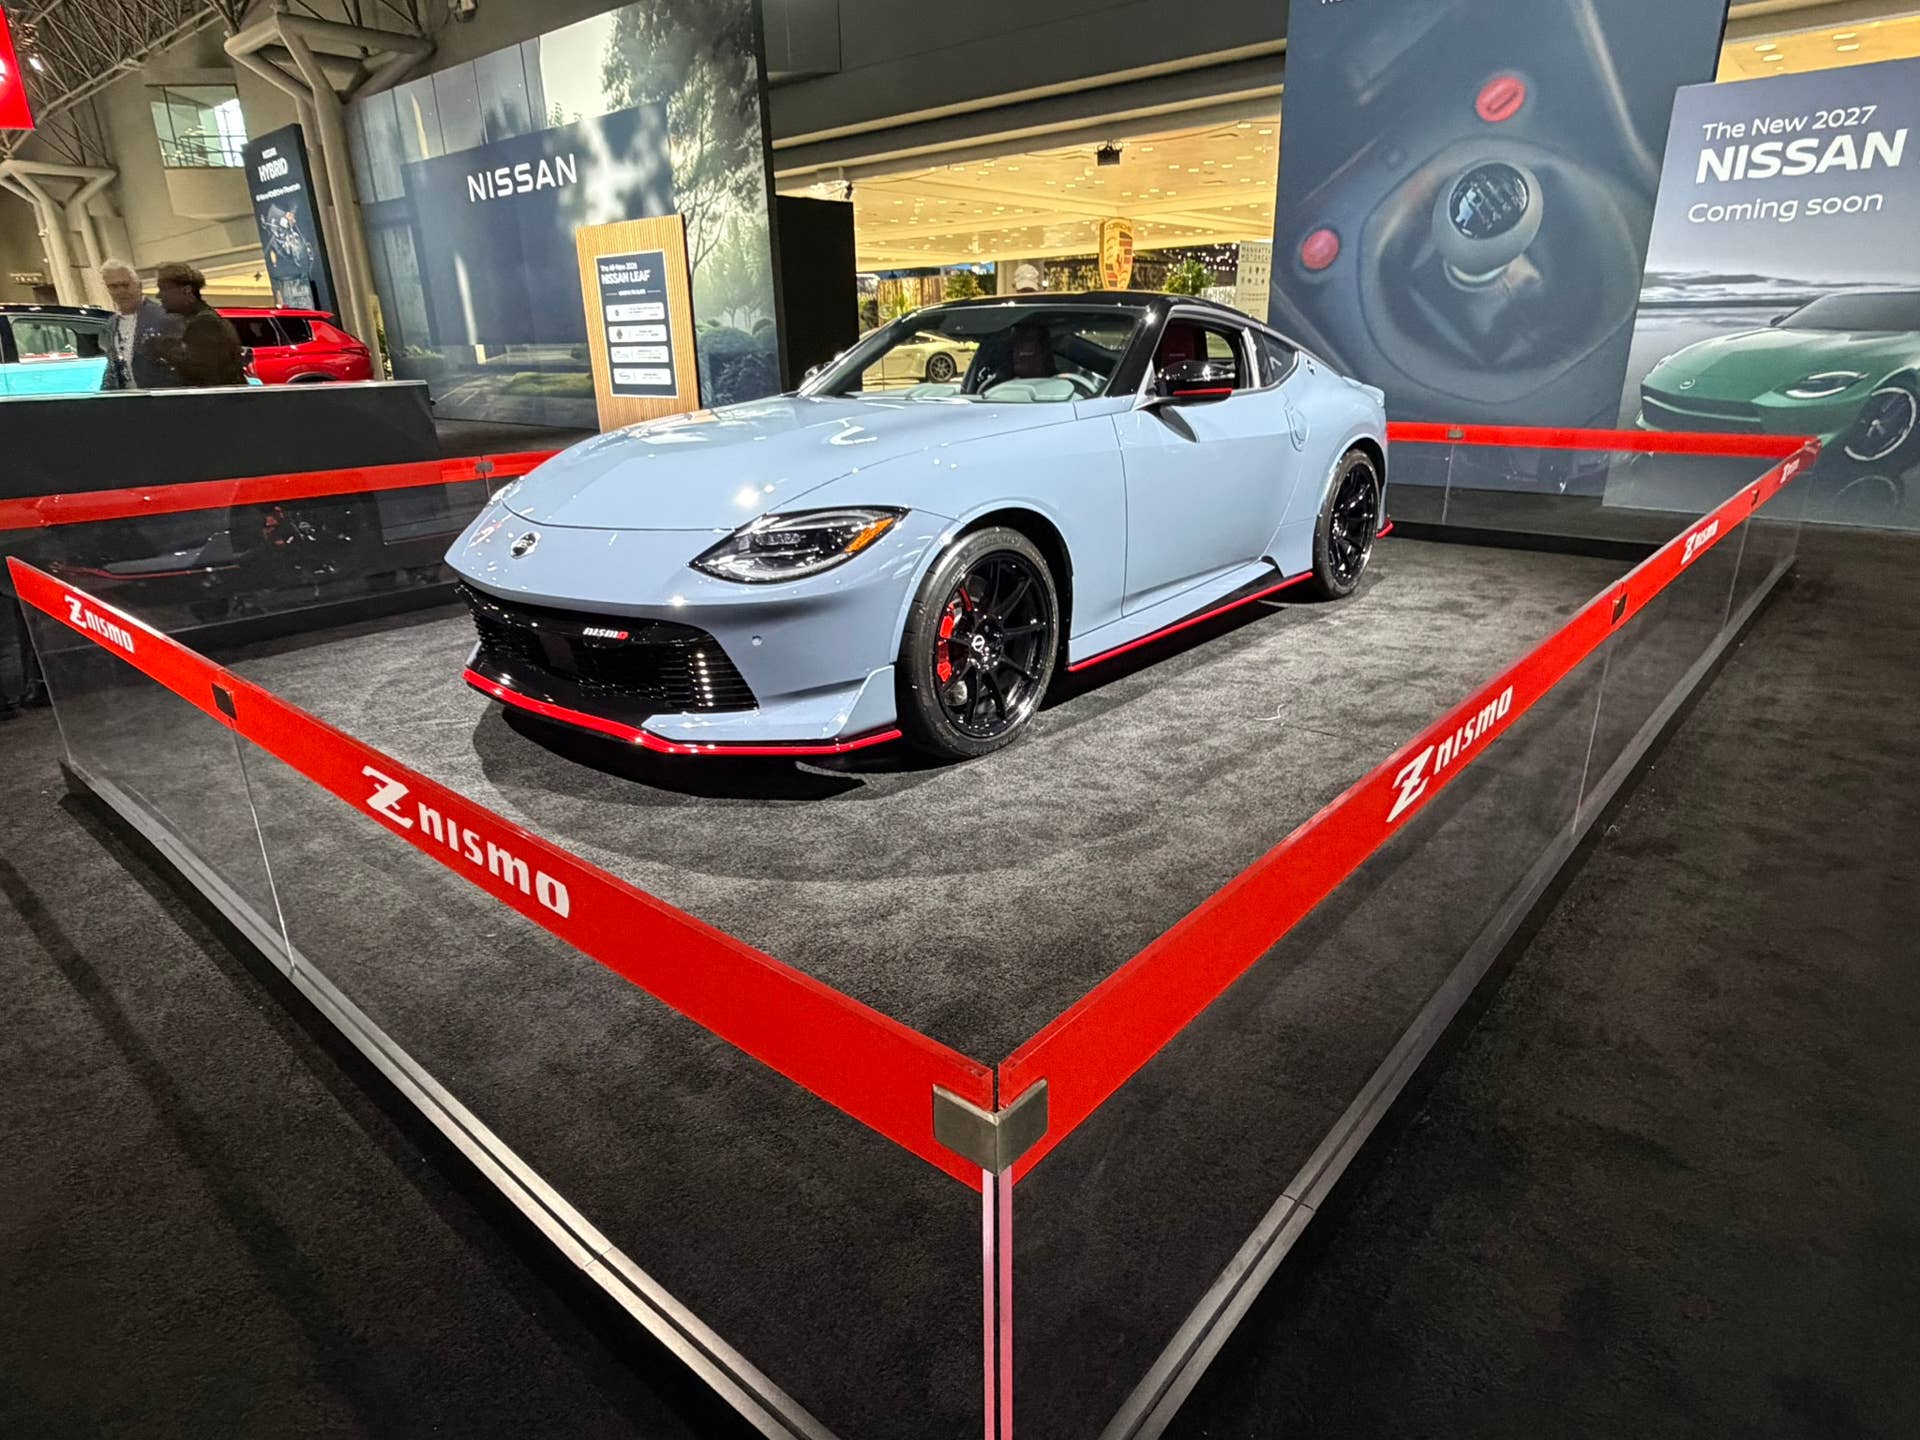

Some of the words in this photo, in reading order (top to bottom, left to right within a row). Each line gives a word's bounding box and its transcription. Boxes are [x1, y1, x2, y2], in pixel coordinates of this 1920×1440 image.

[1702, 122, 1746, 142] The
[1751, 115, 1809, 137] New
[1811, 104, 1878, 131] 2027
[257, 156, 289, 183] HYBRID
[1695, 128, 1909, 185] NISSAN
[466, 153, 578, 203] NISSAN
[1687, 198, 1800, 223] Coming
[1804, 192, 1884, 216] soon
